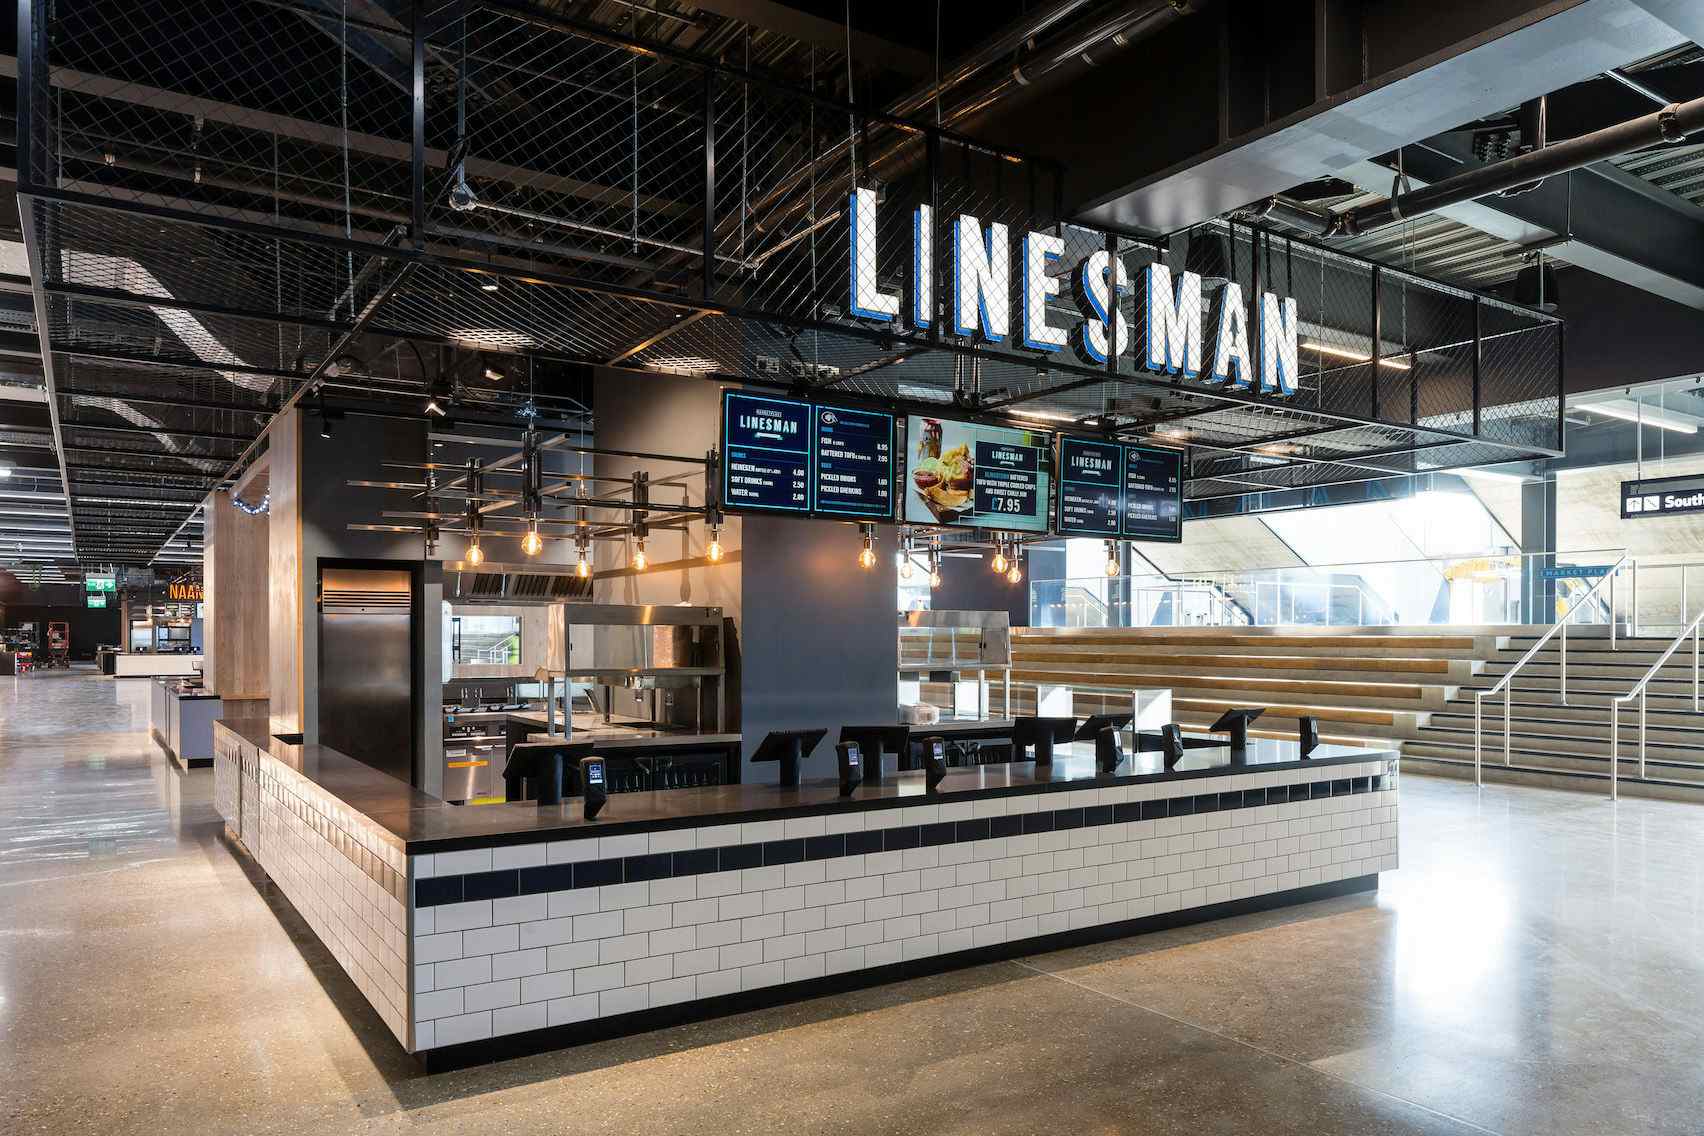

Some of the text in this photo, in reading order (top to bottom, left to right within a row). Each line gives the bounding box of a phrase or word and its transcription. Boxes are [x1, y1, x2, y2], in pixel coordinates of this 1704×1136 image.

[849, 187, 1299, 396] LINESMAN
[739, 415, 798, 434] LINESMAN
[992, 450, 1024, 461] LINESMAN
[1071, 456, 1112, 471] LINESMAN
[992, 496, 1021, 513] £7.95
[1664, 493, 1704, 509] South
